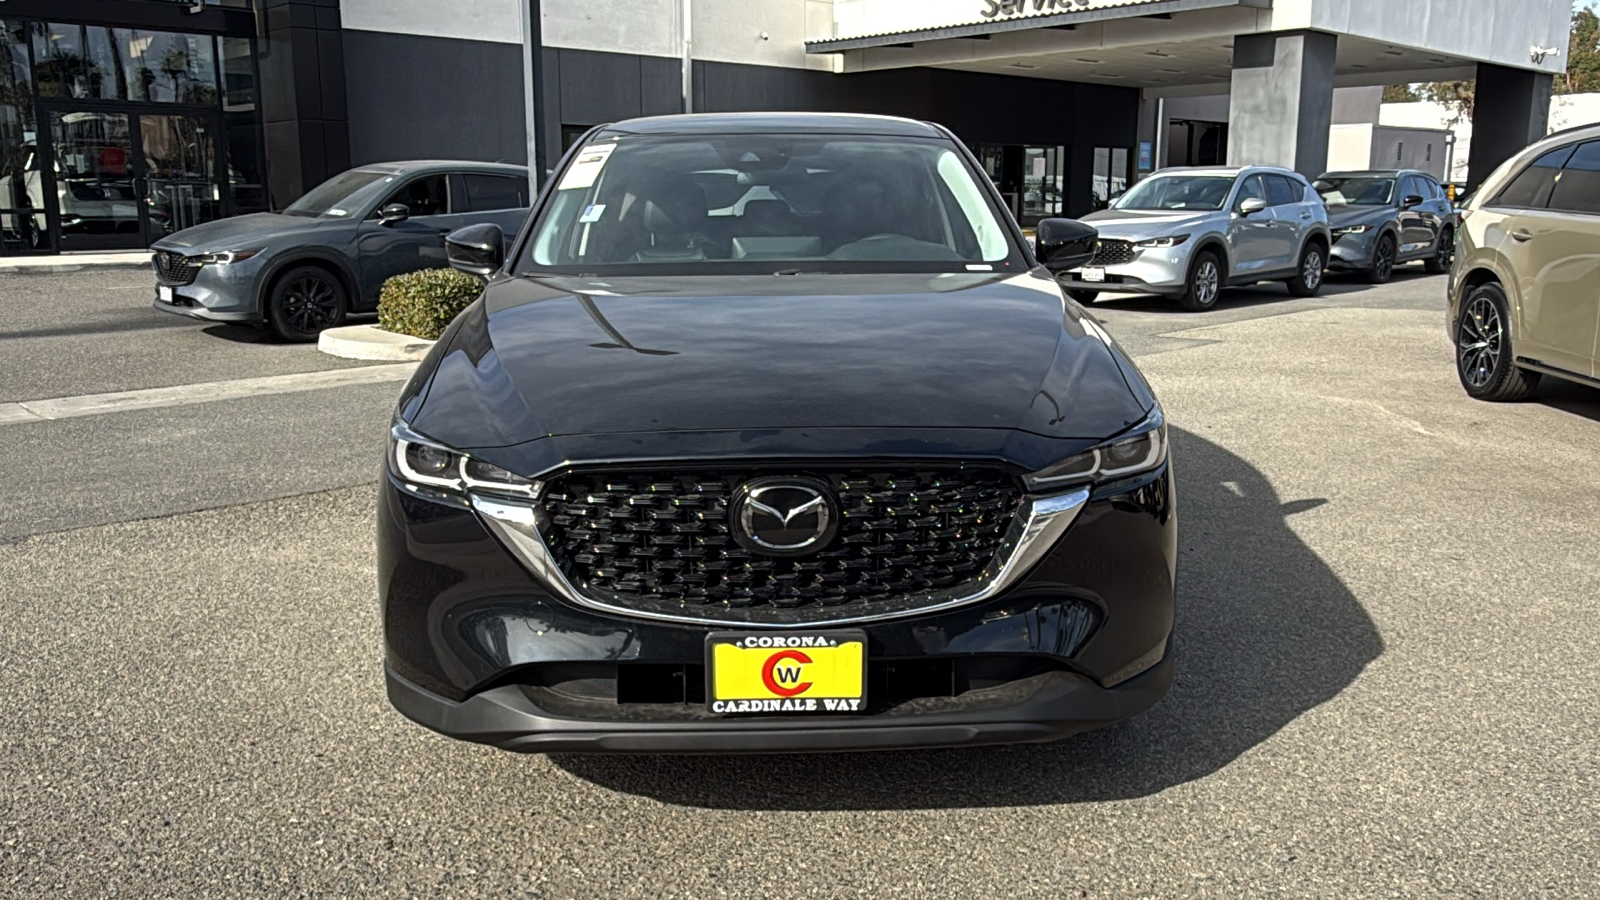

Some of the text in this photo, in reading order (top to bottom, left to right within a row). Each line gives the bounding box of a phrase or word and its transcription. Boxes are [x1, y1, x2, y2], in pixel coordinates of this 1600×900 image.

[744, 636, 828, 648] CORONA
[712, 699, 861, 713] CARDINALE WAY
